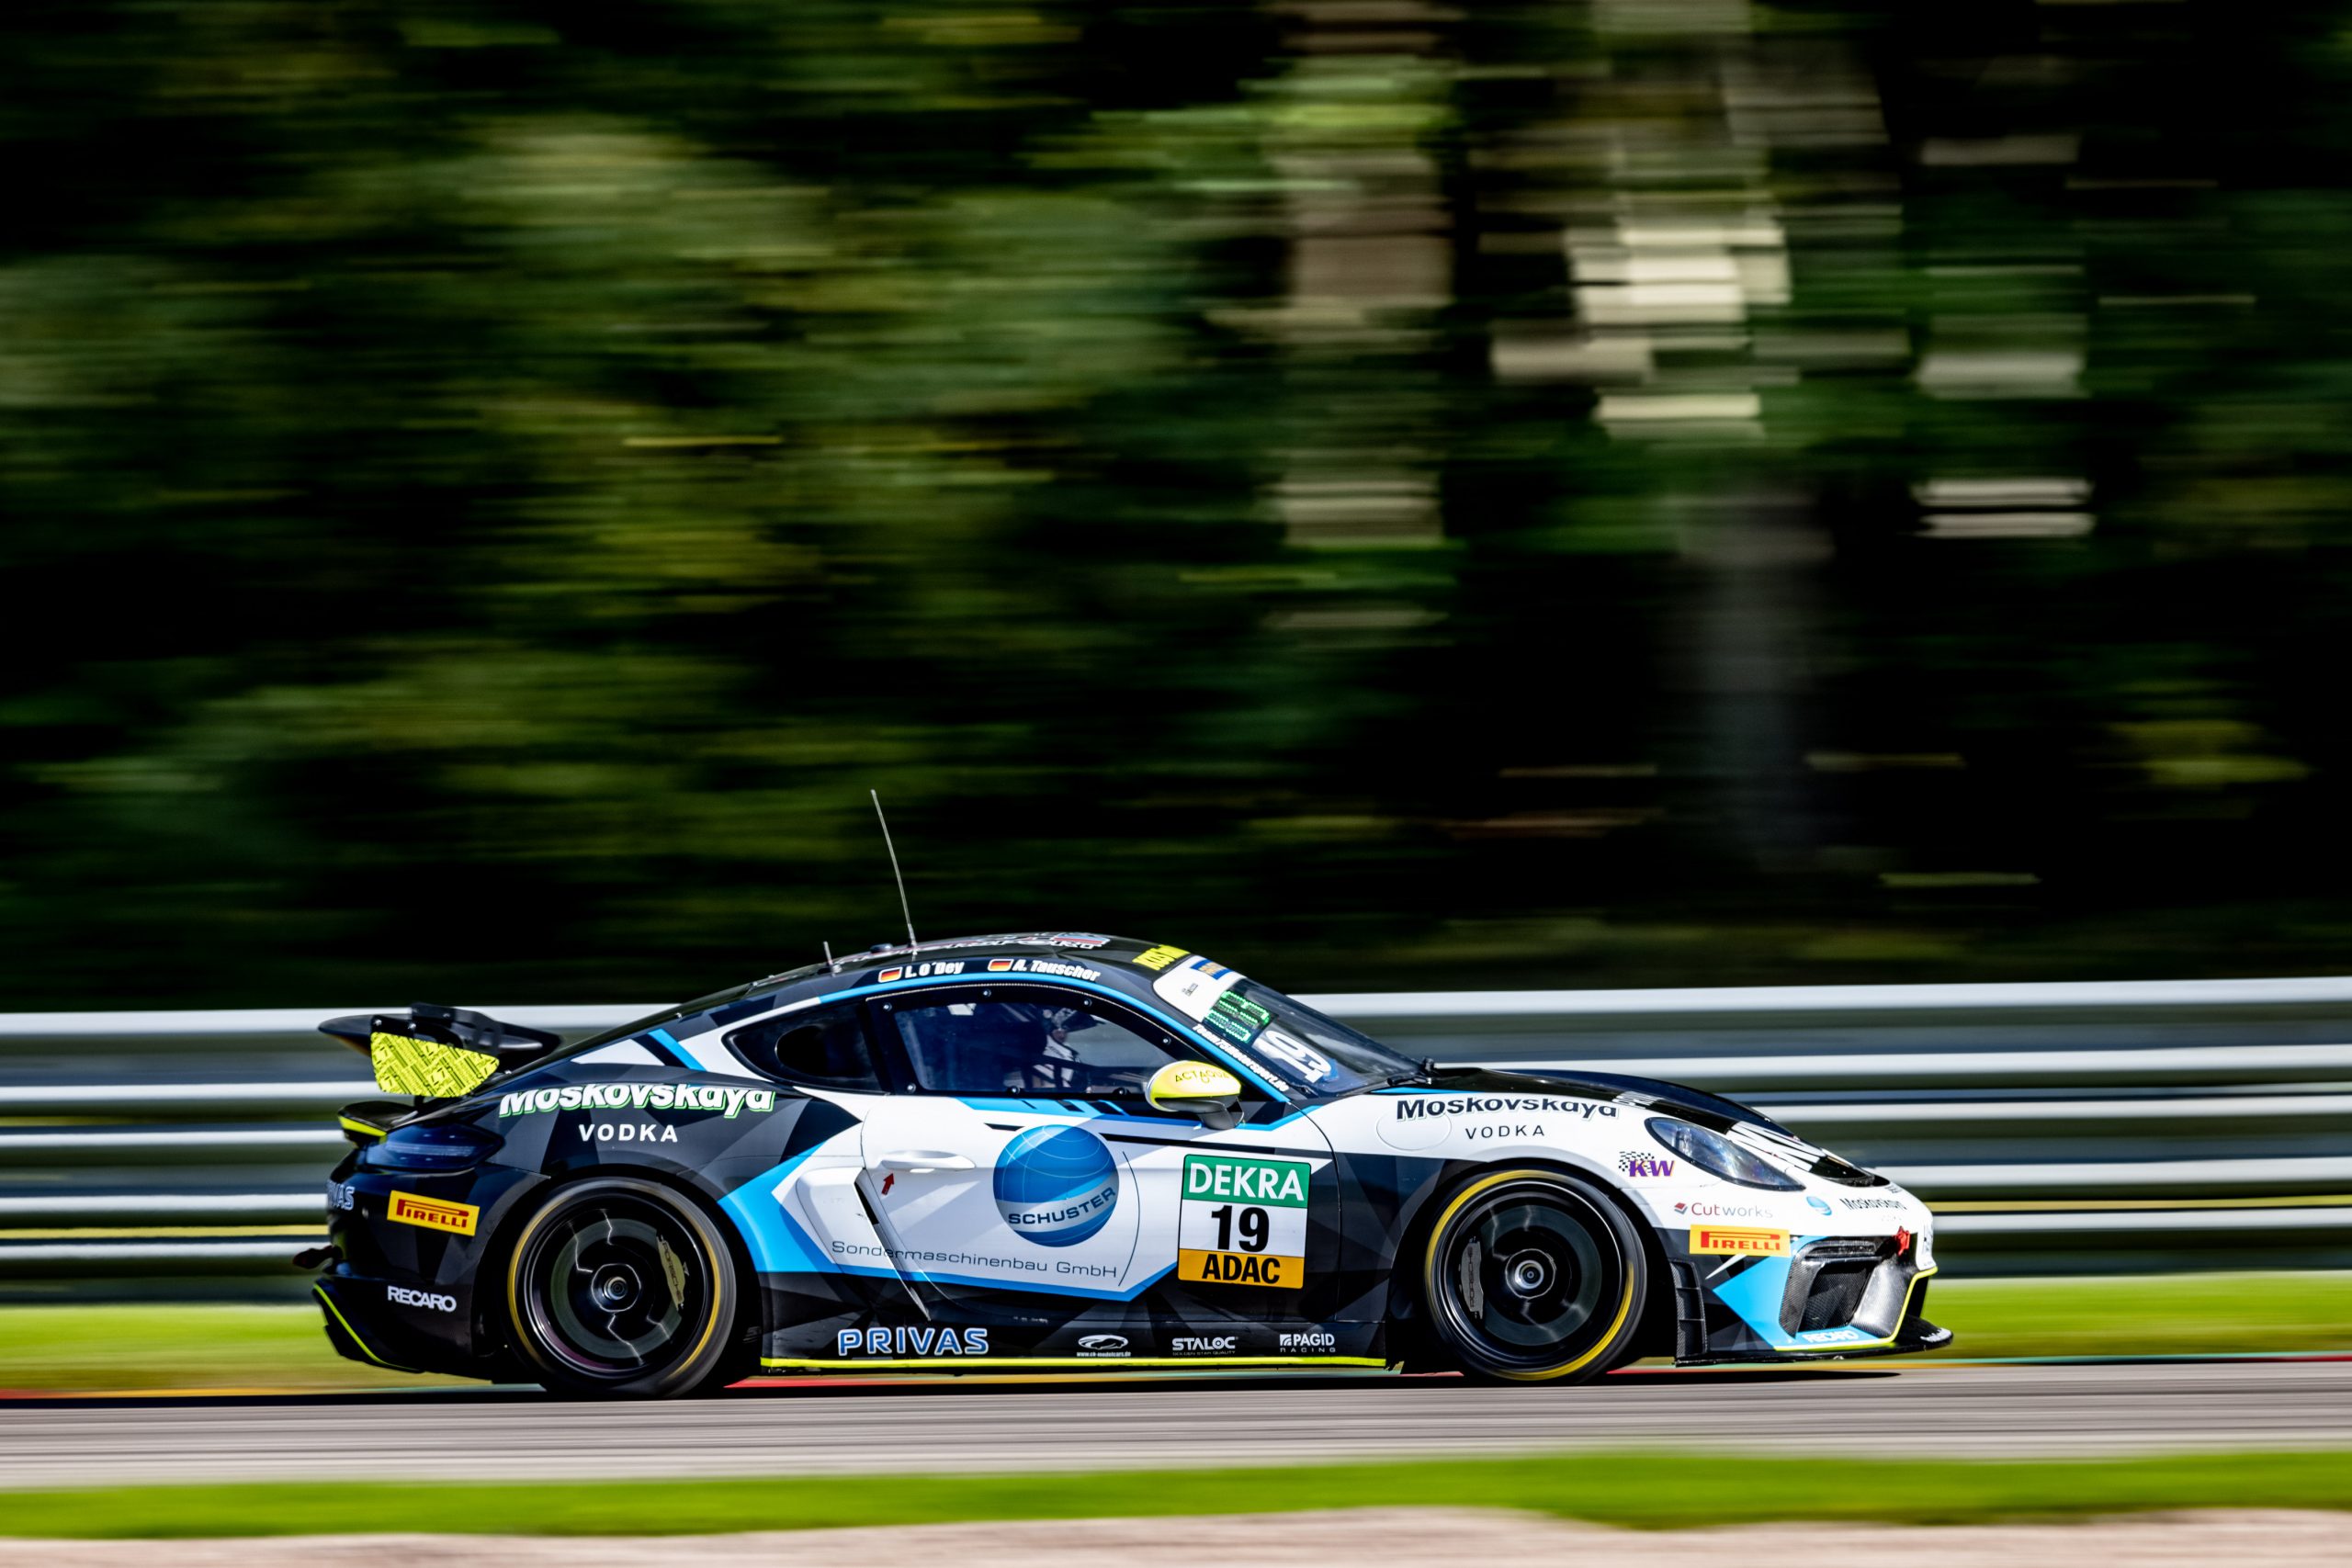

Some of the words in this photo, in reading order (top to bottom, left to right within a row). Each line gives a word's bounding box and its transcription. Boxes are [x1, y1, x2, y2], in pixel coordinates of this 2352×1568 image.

[904, 964, 917, 978] L.
[1012, 961, 1027, 973] A.
[1030, 960, 1102, 982] Tauscher
[499, 1084, 775, 1119] Moskovskaya
[1396, 1097, 1619, 1122] Moskovskaya
[578, 1123, 678, 1143] VODKA
[1465, 1124, 1545, 1140] VODKA
[1629, 1160, 1676, 1177] KW
[1188, 1162, 1305, 1201] DEKRA
[396, 1199, 469, 1228] PIRELLI
[1007, 1186, 1117, 1225] SCHUSTER
[1691, 1201, 1773, 1219] Cutworks
[1211, 1204, 1270, 1253] 19
[1700, 1231, 1781, 1251] PIRELLI
[831, 1240, 1047, 1272] Sondermaschinenbau
[1057, 1260, 1117, 1278] GmbH
[1201, 1253, 1281, 1284] ADAC
[387, 1285, 458, 1313] RECARO
[837, 1326, 989, 1357] PRIVAS
[1171, 1336, 1236, 1351] STALOC
[1293, 1334, 1336, 1347] PAGID
